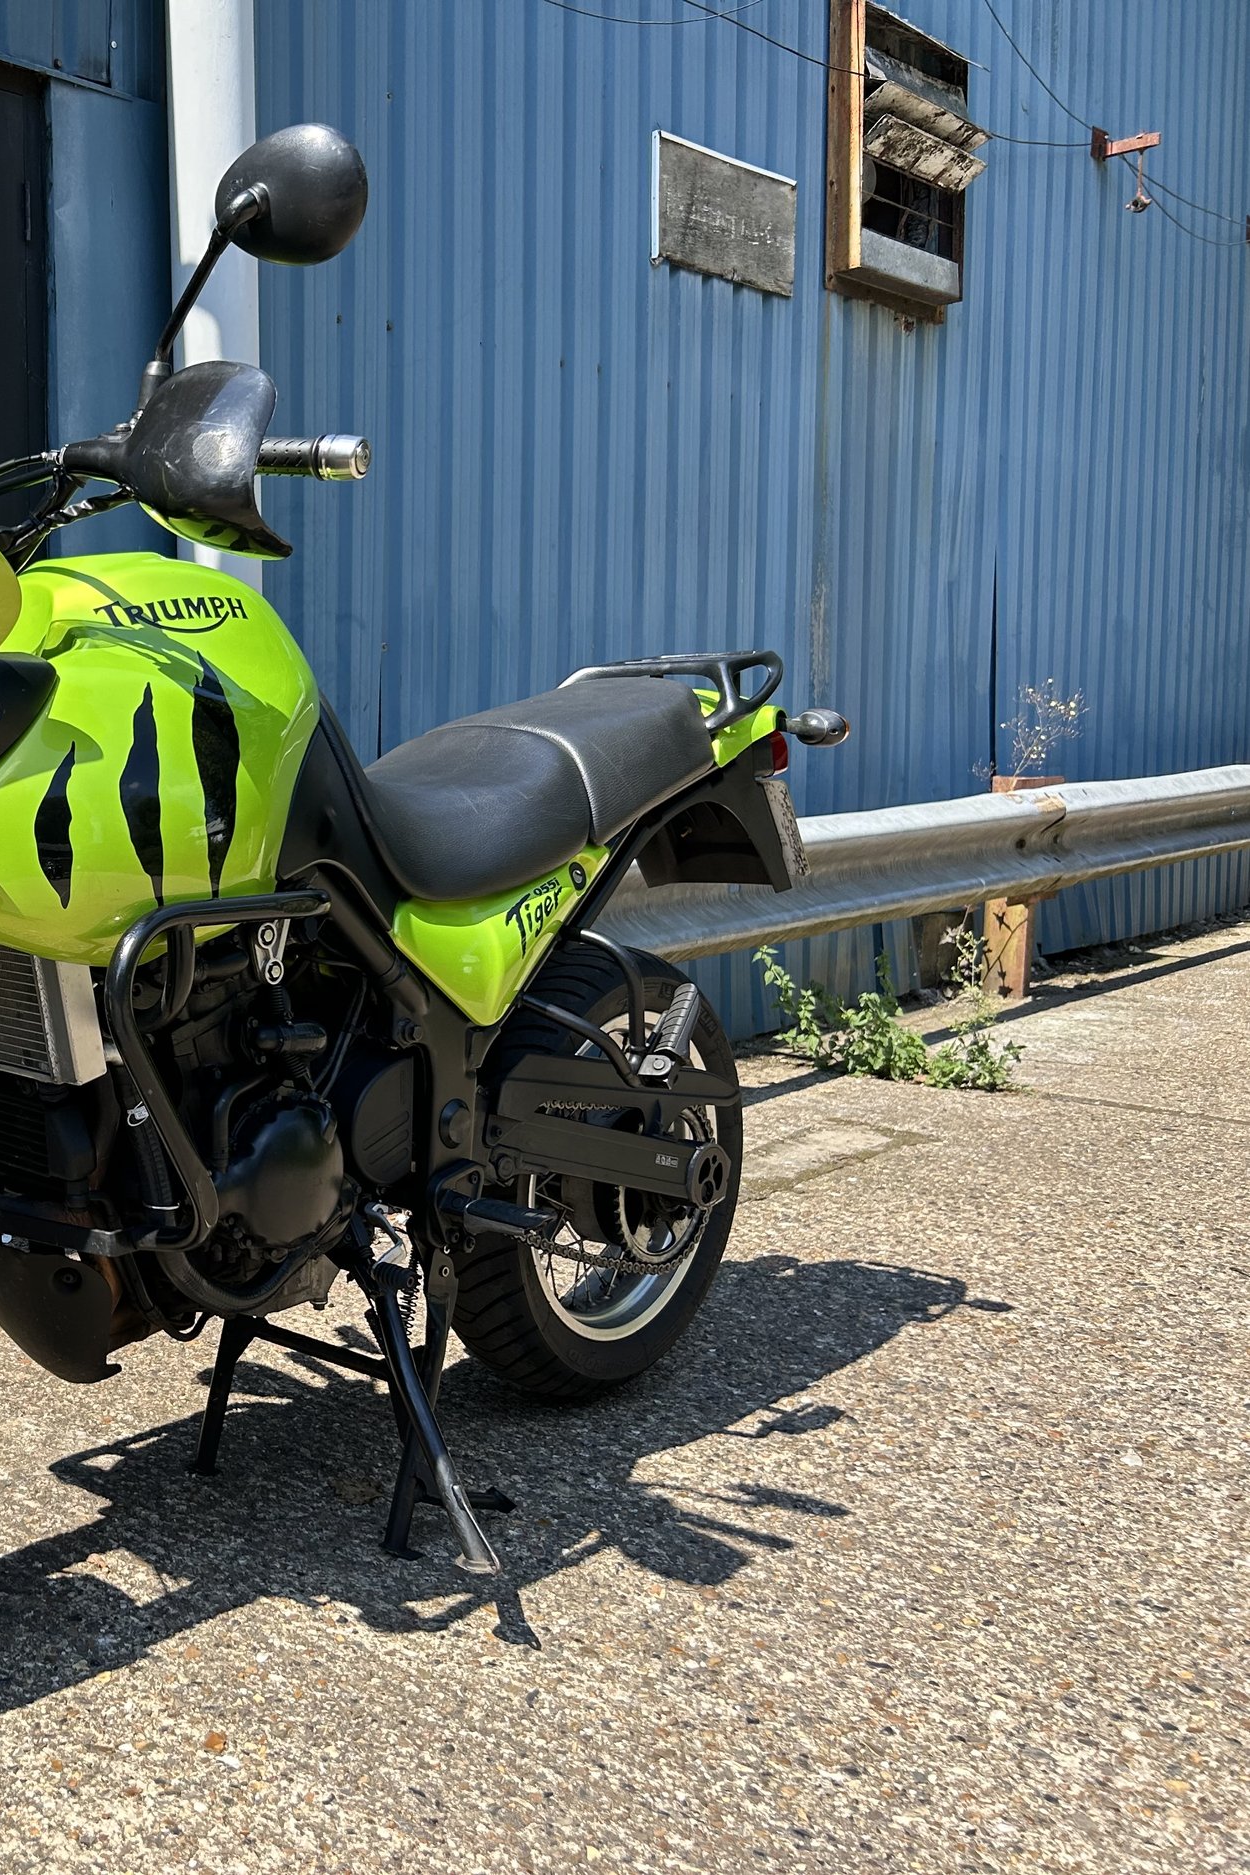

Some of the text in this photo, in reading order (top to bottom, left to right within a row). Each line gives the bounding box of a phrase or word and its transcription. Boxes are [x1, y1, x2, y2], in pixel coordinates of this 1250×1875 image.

[93, 596, 248, 633] TRIUMPH
[533, 877, 560, 896] 955i
[505, 885, 563, 959] Tiger
